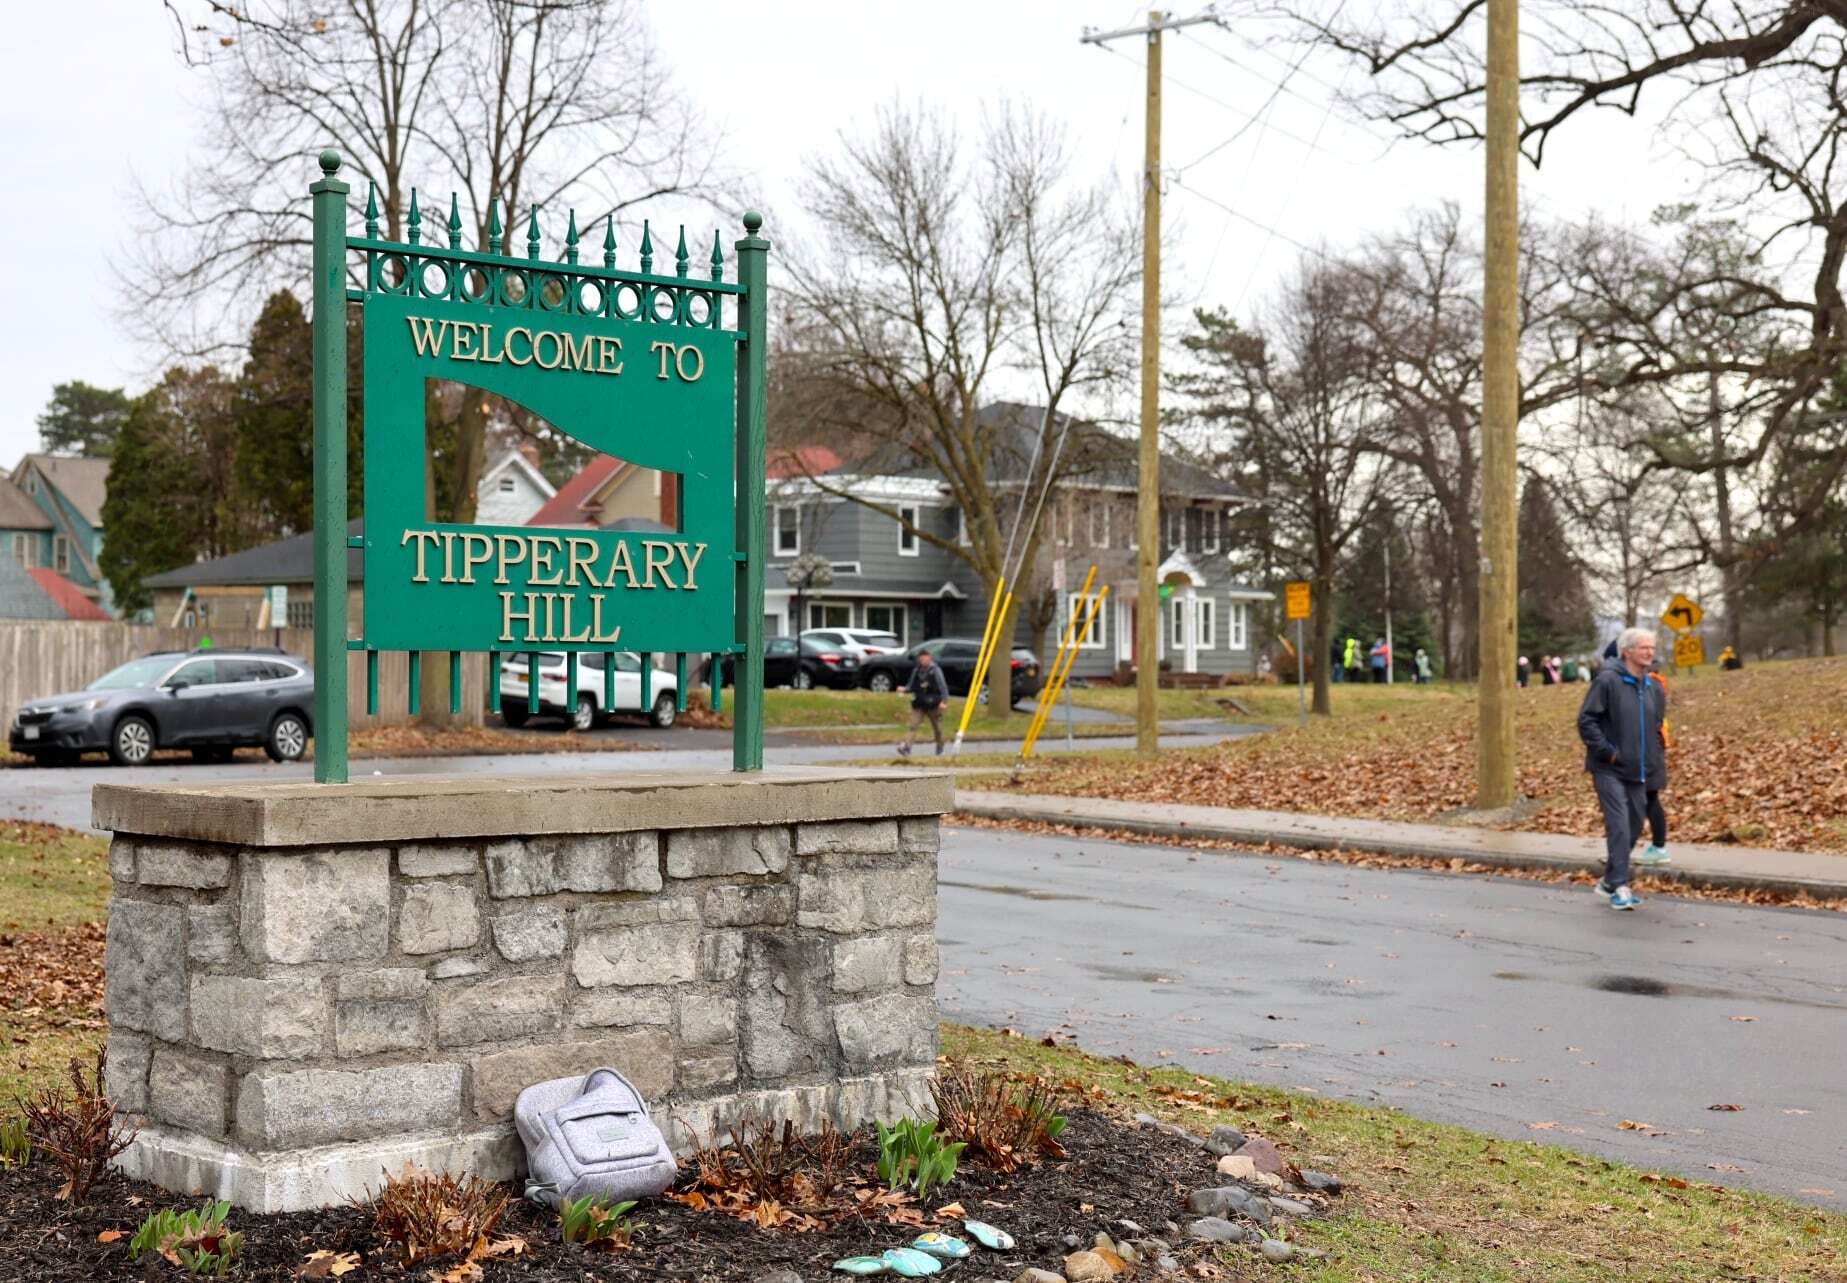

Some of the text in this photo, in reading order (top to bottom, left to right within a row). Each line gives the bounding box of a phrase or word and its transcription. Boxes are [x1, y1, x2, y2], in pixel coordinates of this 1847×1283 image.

[406, 316, 704, 382] WELCOME TO
[401, 529, 707, 589] TIPPERARY
[499, 592, 620, 642] HILL
[1677, 640, 1700, 655] 20
